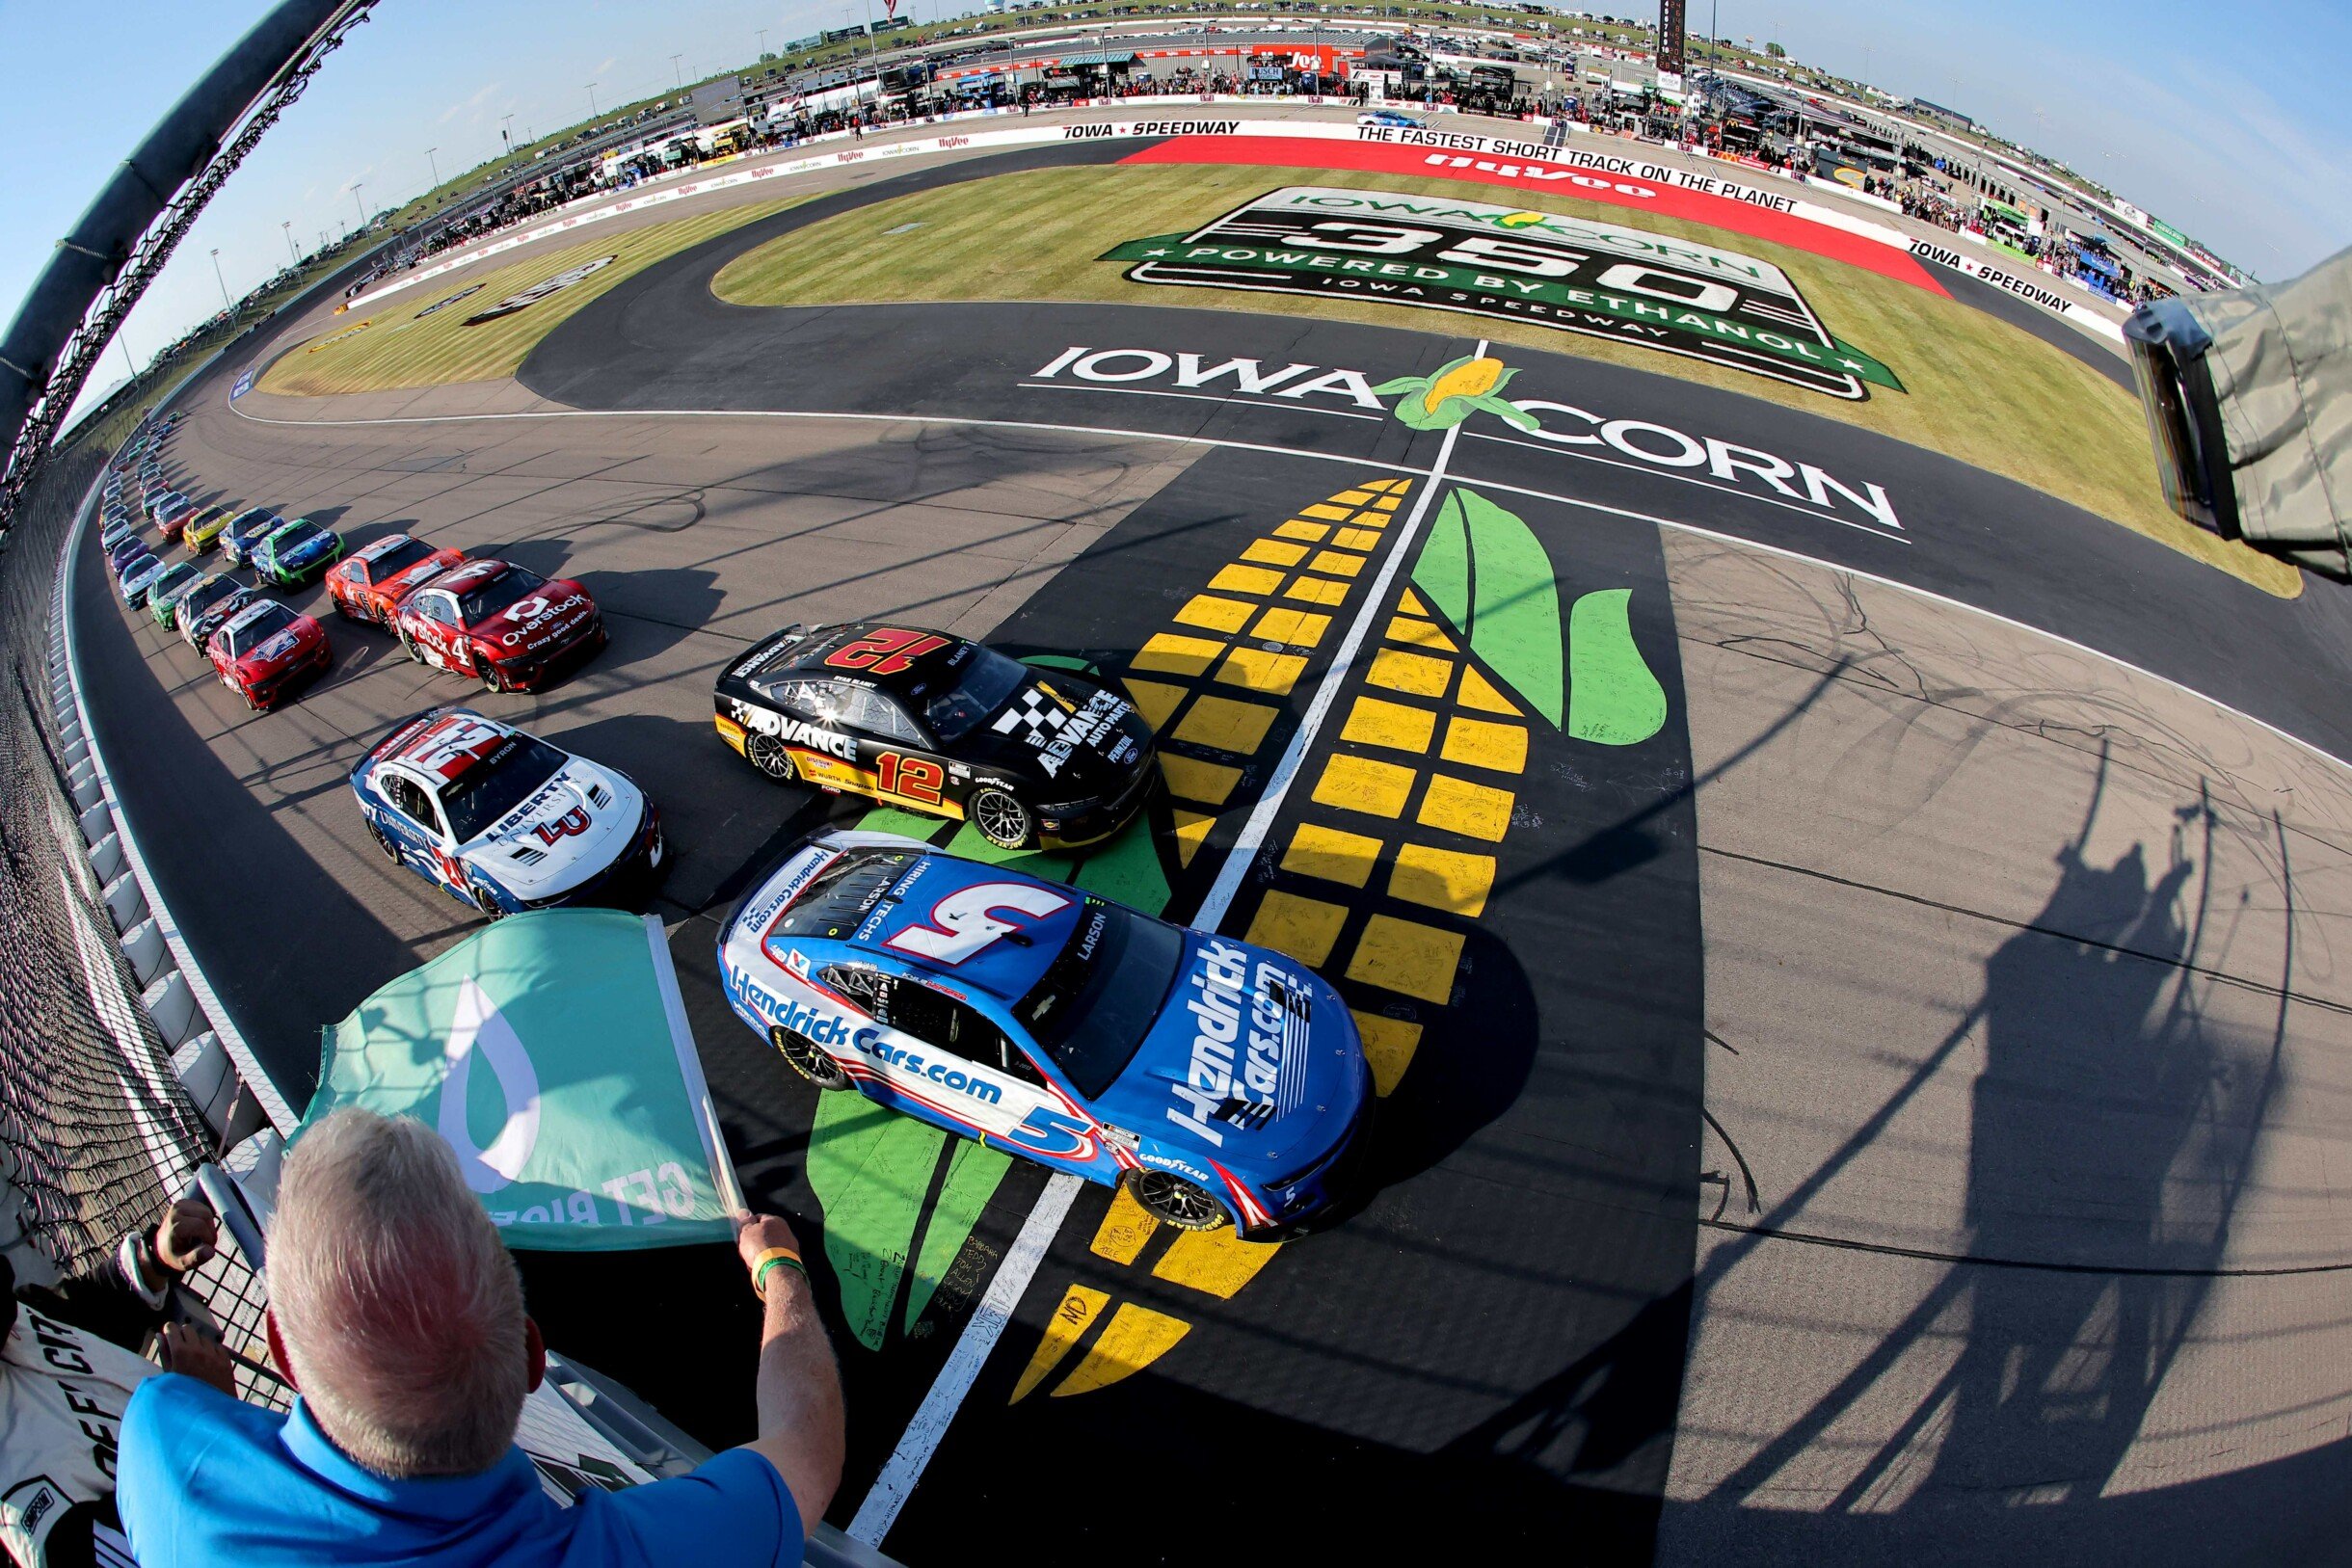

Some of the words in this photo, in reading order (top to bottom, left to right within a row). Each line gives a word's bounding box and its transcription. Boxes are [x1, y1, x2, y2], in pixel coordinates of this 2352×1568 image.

[938, 137, 969, 149] HyVee
[1063, 124, 1112, 139] IOWA
[1132, 121, 1241, 136] SPEEDWAY
[751, 167, 774, 179] HyVee
[837, 150, 865, 163] HyVee
[1356, 126, 1394, 144] THE
[1401, 128, 1487, 151] FASTEST
[1492, 139, 1562, 163] SHORT
[1568, 148, 1636, 175] TRACK
[1641, 164, 1670, 183] ON
[1677, 172, 1716, 192] THE
[1721, 183, 1799, 214] PLANET
[1424, 152, 1658, 199] HyVee
[678, 184, 698, 196] HyVee
[1290, 195, 1497, 226] IOWA
[1546, 223, 1763, 278] CORN
[1281, 223, 1739, 313] 350
[1909, 237, 1962, 269] IOWA
[1977, 265, 2073, 313] SPEEDWAY
[1187, 247, 1450, 281] POWERED
[1473, 274, 1544, 296] BY
[1566, 289, 1821, 361] ETHANOL
[1323, 278, 1424, 299] IOWA
[1450, 292, 1670, 339] SPEEDWAY
[1032, 346, 1390, 411] IOWA
[1499, 398, 1911, 532] CORN
[502, 594, 584, 647] Overstock
[527, 635, 550, 651] Crazy
[551, 622, 570, 638] good
[570, 610, 589, 627] deals.
[452, 635, 470, 667] 4
[735, 640, 783, 678] ADVANCE
[823, 628, 952, 676] 12
[947, 645, 971, 667] BLANEY
[852, 678, 877, 688] BLANEY
[372, 719, 428, 763] LIBERTY
[747, 706, 858, 763] ADVANCE
[1036, 688, 1120, 779] ADVANCE
[1086, 722, 1111, 748] AUTO
[1105, 701, 1131, 725] PARTS
[489, 741, 518, 765] BYRON
[1107, 734, 1134, 763] PENNZOIL
[820, 784, 841, 794] FORD
[875, 750, 946, 807] 12
[975, 777, 1014, 791] GOODYEAR
[485, 771, 572, 843] LIBERTY
[529, 804, 592, 847] LU
[750, 849, 830, 933] HendrickCars.com
[894, 861, 931, 896] HIRING
[858, 904, 894, 942] TECHS
[879, 881, 1077, 969] 5
[1077, 912, 1107, 962] LARSON
[1166, 941, 1248, 1148] Hendrick
[1007, 1103, 1095, 1158] 5
[1138, 1154, 1210, 1182] GOODYEAR
[1283, 1185, 1296, 1208] 5
[24, 1492, 51, 1532] SIMPSON
